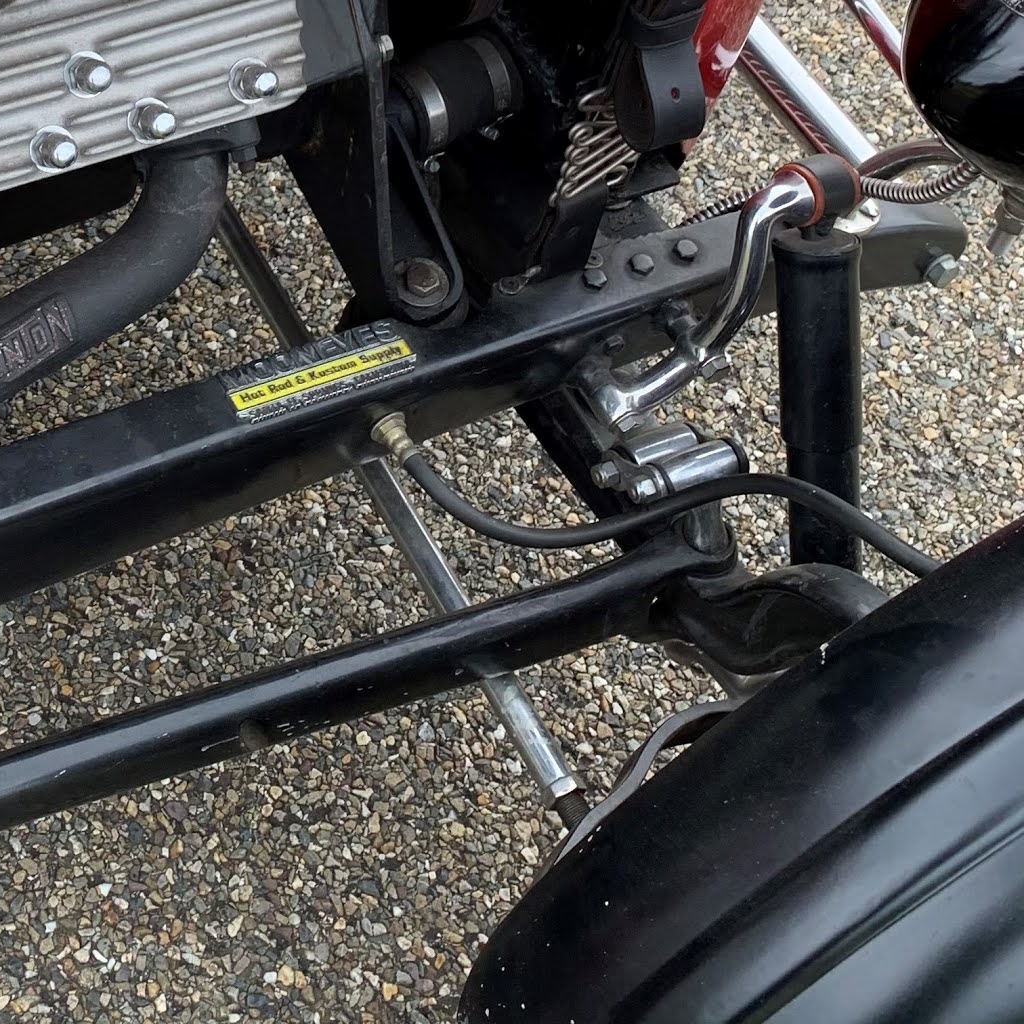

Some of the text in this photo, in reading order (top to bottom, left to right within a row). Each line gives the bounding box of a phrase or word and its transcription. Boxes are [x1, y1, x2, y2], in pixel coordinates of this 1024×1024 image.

[219, 321, 402, 391] MOONEYES
[239, 345, 403, 403] Hot Rod & Kustom Supply
